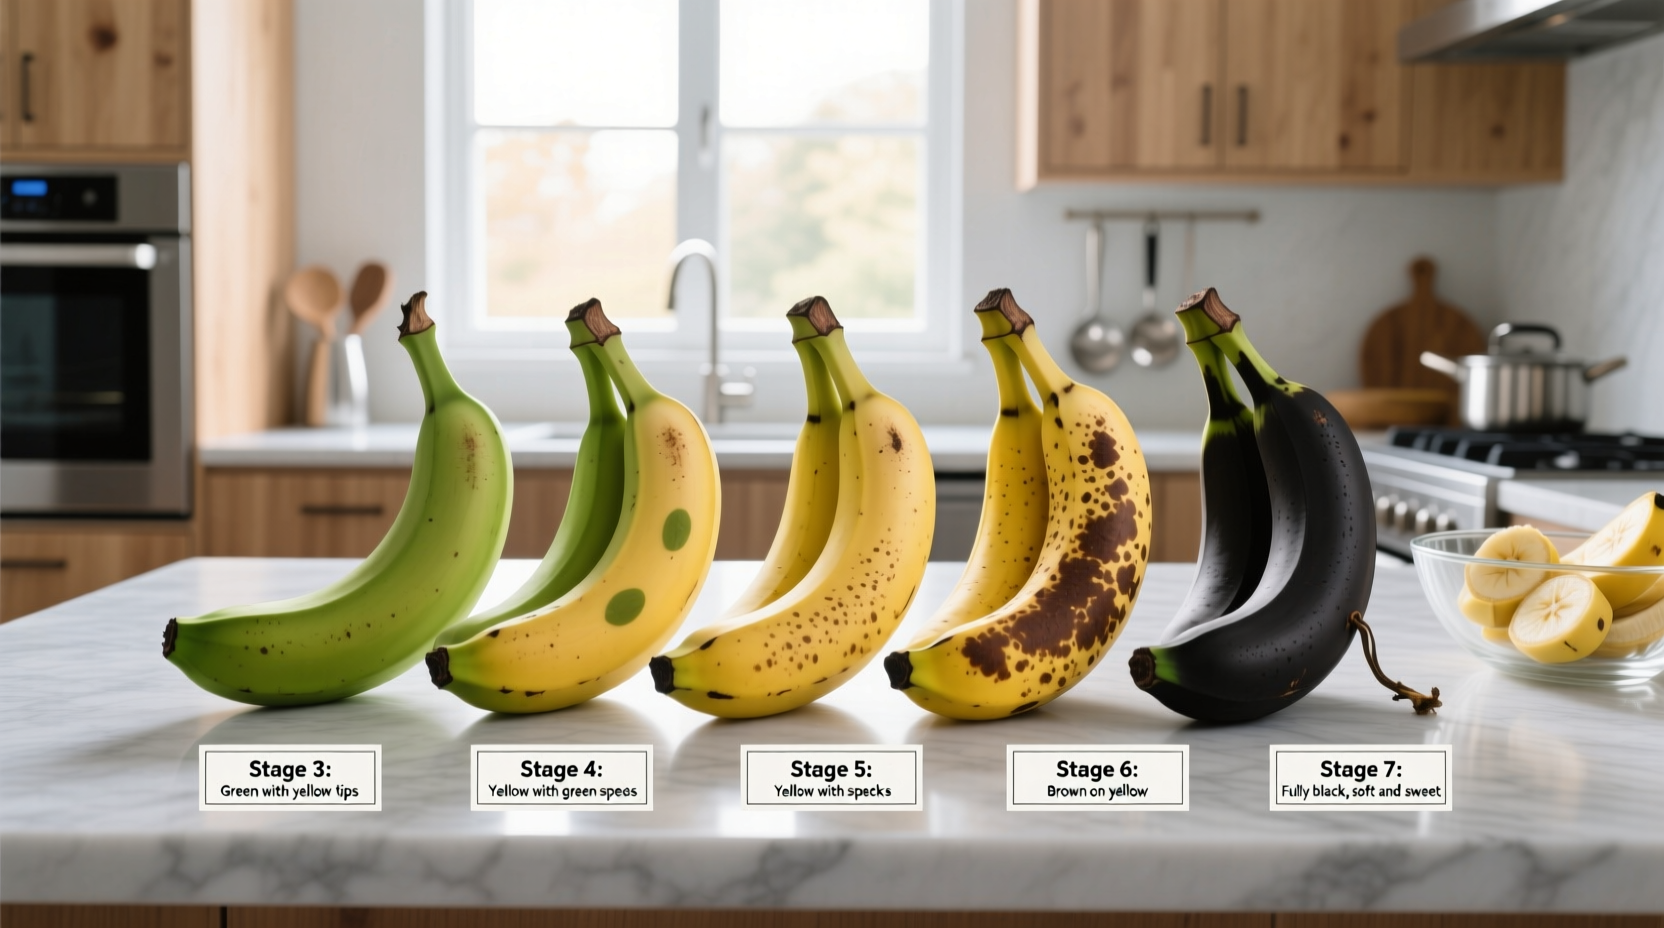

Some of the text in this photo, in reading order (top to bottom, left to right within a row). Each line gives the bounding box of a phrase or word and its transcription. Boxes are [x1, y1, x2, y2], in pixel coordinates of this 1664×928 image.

[249, 760, 331, 782] Stage 3:
[521, 760, 603, 782] Stage 4:
[791, 760, 872, 782] Stage 5:
[1057, 760, 1138, 782] Stage 6:
[1321, 760, 1402, 782] Stage 7:
[220, 784, 359, 801] Green with yellow tips
[489, 784, 529, 797] Yellow
[533, 784, 559, 797] with
[562, 787, 597, 800] green
[775, 784, 892, 801] Yellow with specks
[1048, 784, 1148, 801] Brown on yellow
[1282, 784, 1442, 801] Fully black, soft and sweet
